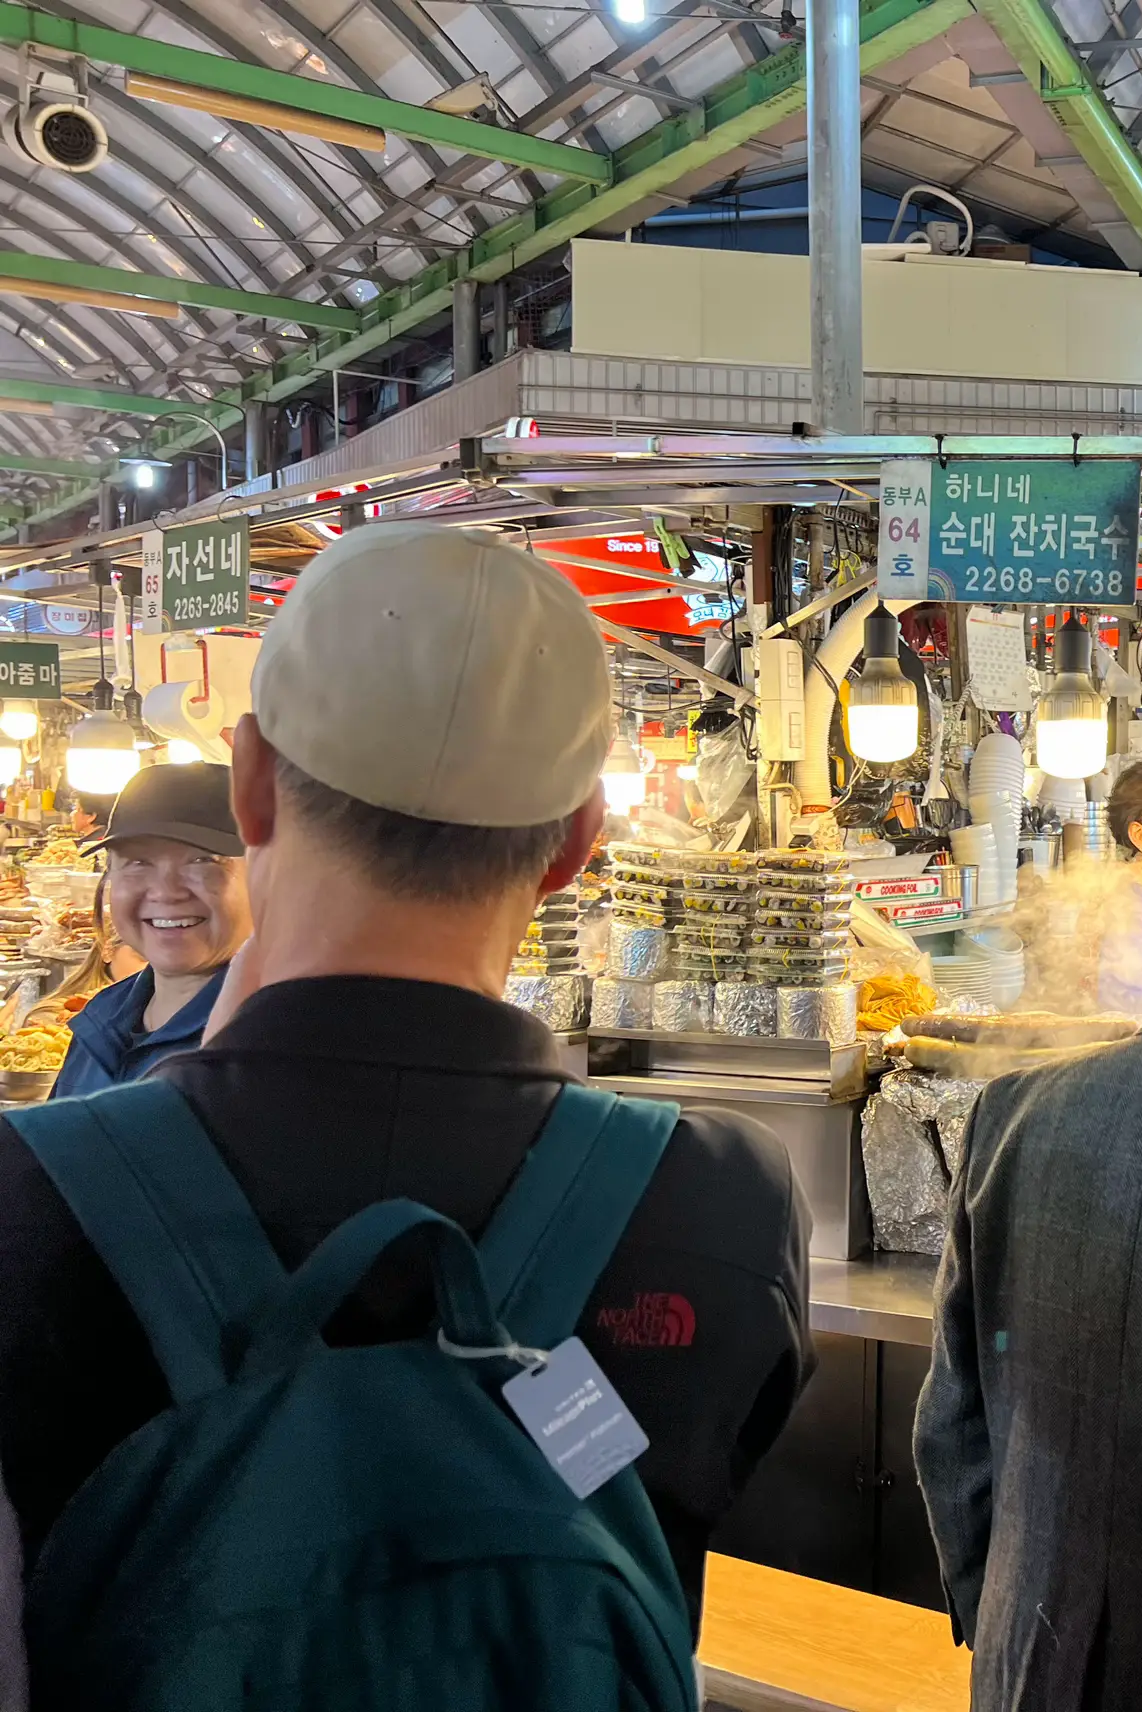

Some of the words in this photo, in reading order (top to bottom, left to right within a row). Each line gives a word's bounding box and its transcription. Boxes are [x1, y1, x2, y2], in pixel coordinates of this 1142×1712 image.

[883, 486, 928, 507] 동부A
[945, 473, 1031, 504] 하니네
[888, 516, 921, 543] 64
[939, 511, 996, 557] 순대
[1009, 512, 1131, 560] 잔치국수
[166, 531, 241, 585] 자선네
[607, 539, 643, 552] Since
[891, 553, 915, 577] 호
[145, 575, 159, 594] 65
[965, 565, 1123, 596] 2268-6738
[147, 601, 158, 618] 호
[174, 590, 239, 620] 2263-2845
[0, 661, 58, 687] 아줌마
[881, 885, 907, 896] COOKING
[907, 883, 918, 894] FOIL
[597, 1307, 664, 1327] NORTH
